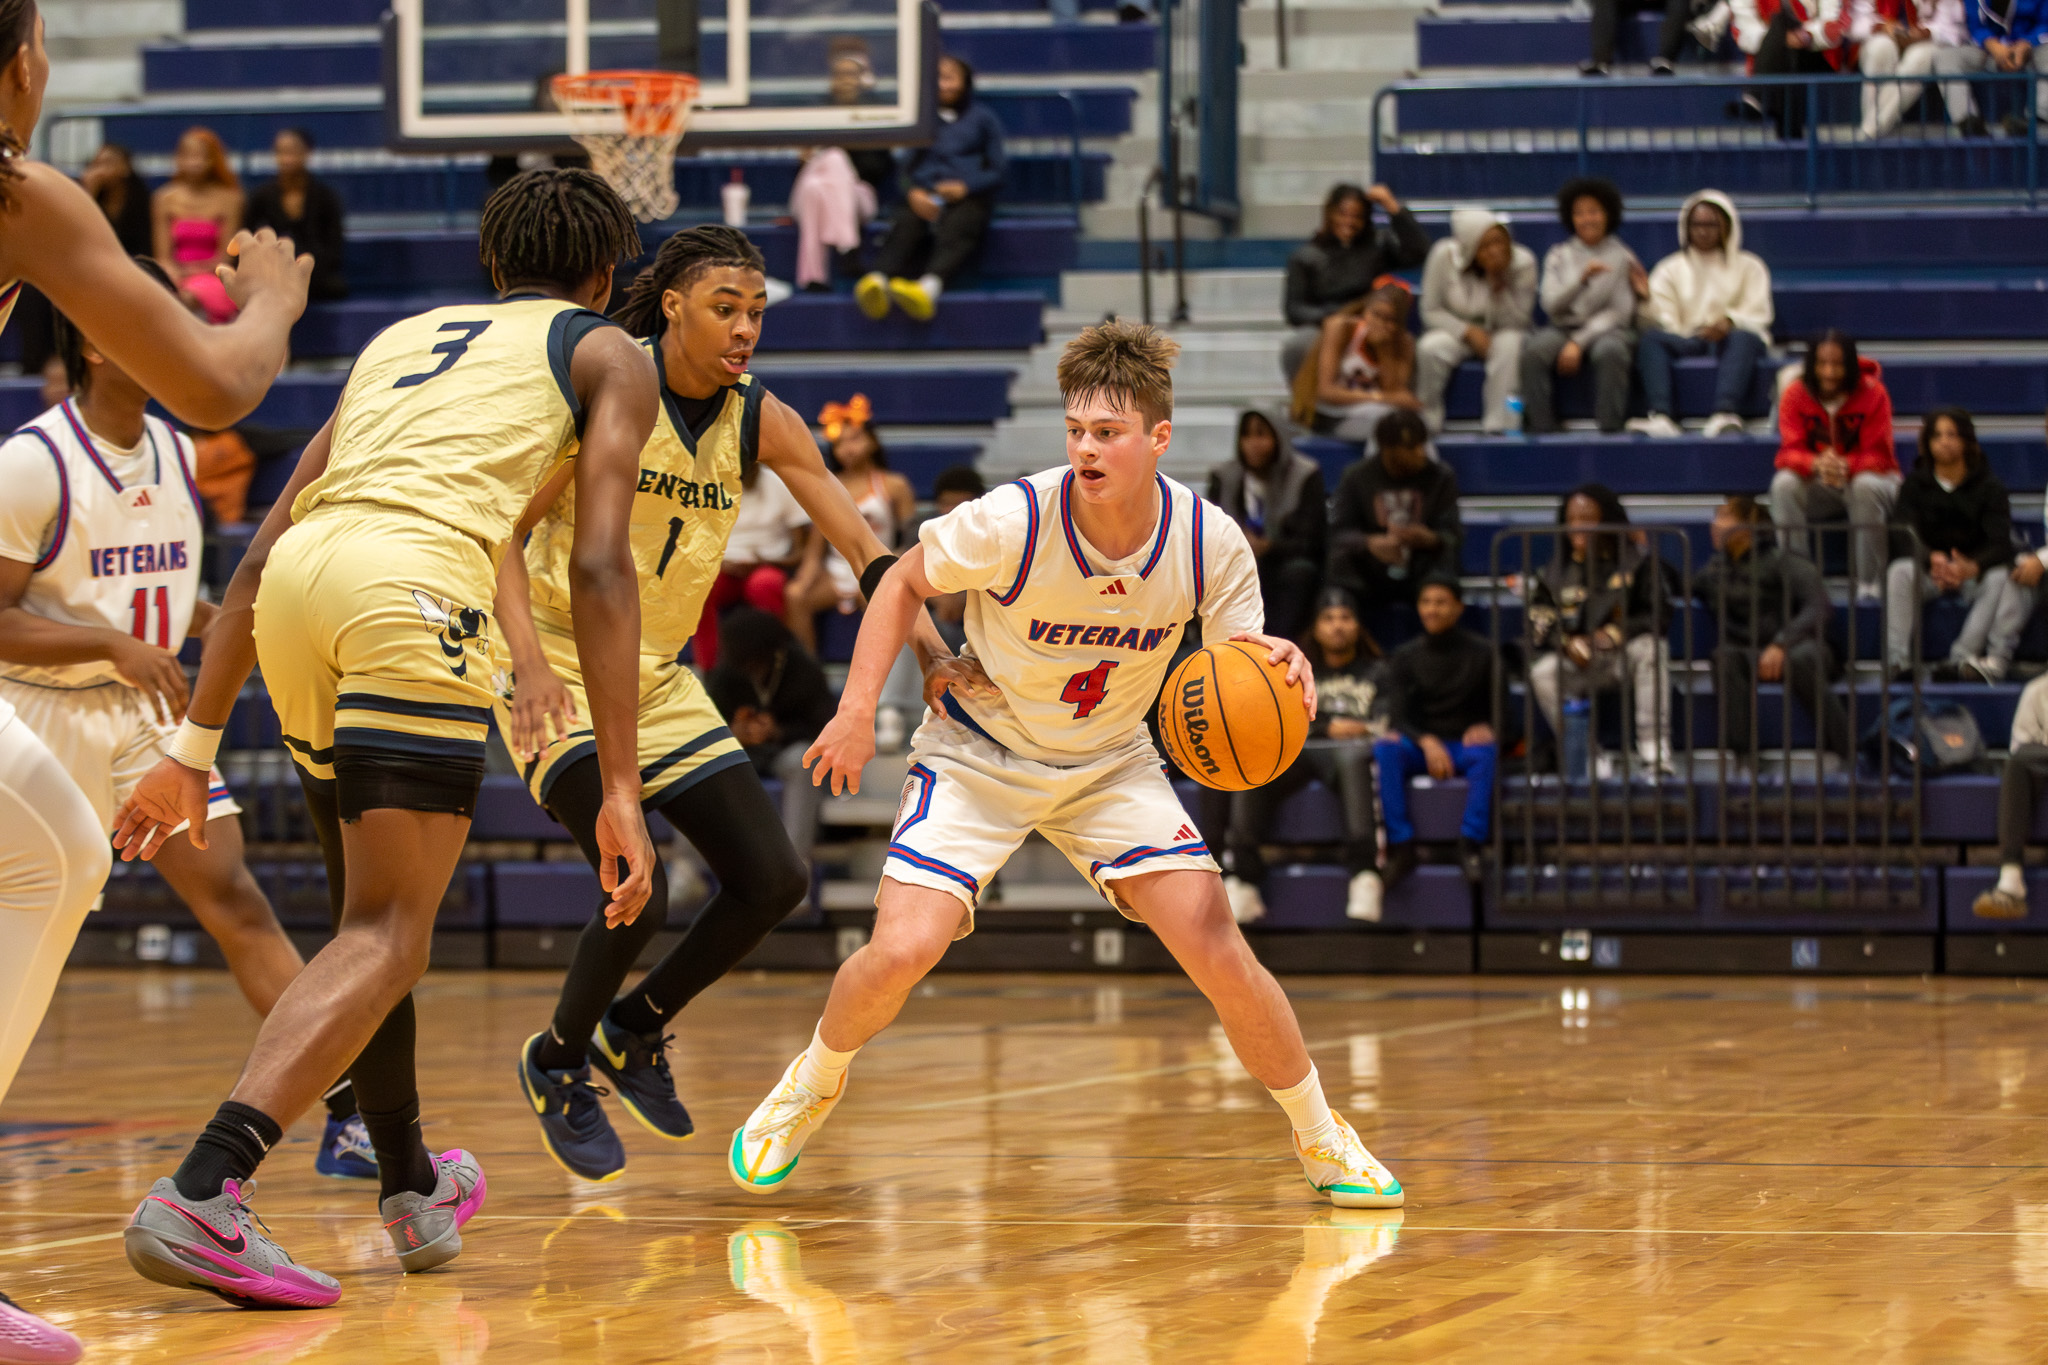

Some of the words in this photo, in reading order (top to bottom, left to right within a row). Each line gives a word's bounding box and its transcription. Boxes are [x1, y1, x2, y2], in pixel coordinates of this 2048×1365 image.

[392, 320, 493, 389] 3
[636, 468, 734, 511] ENTRAL
[89, 540, 188, 578] VETERANS
[656, 516, 685, 581] 1
[129, 586, 170, 650] 11
[1059, 659, 1120, 721] 4
[1182, 675, 1222, 777] Wilson
